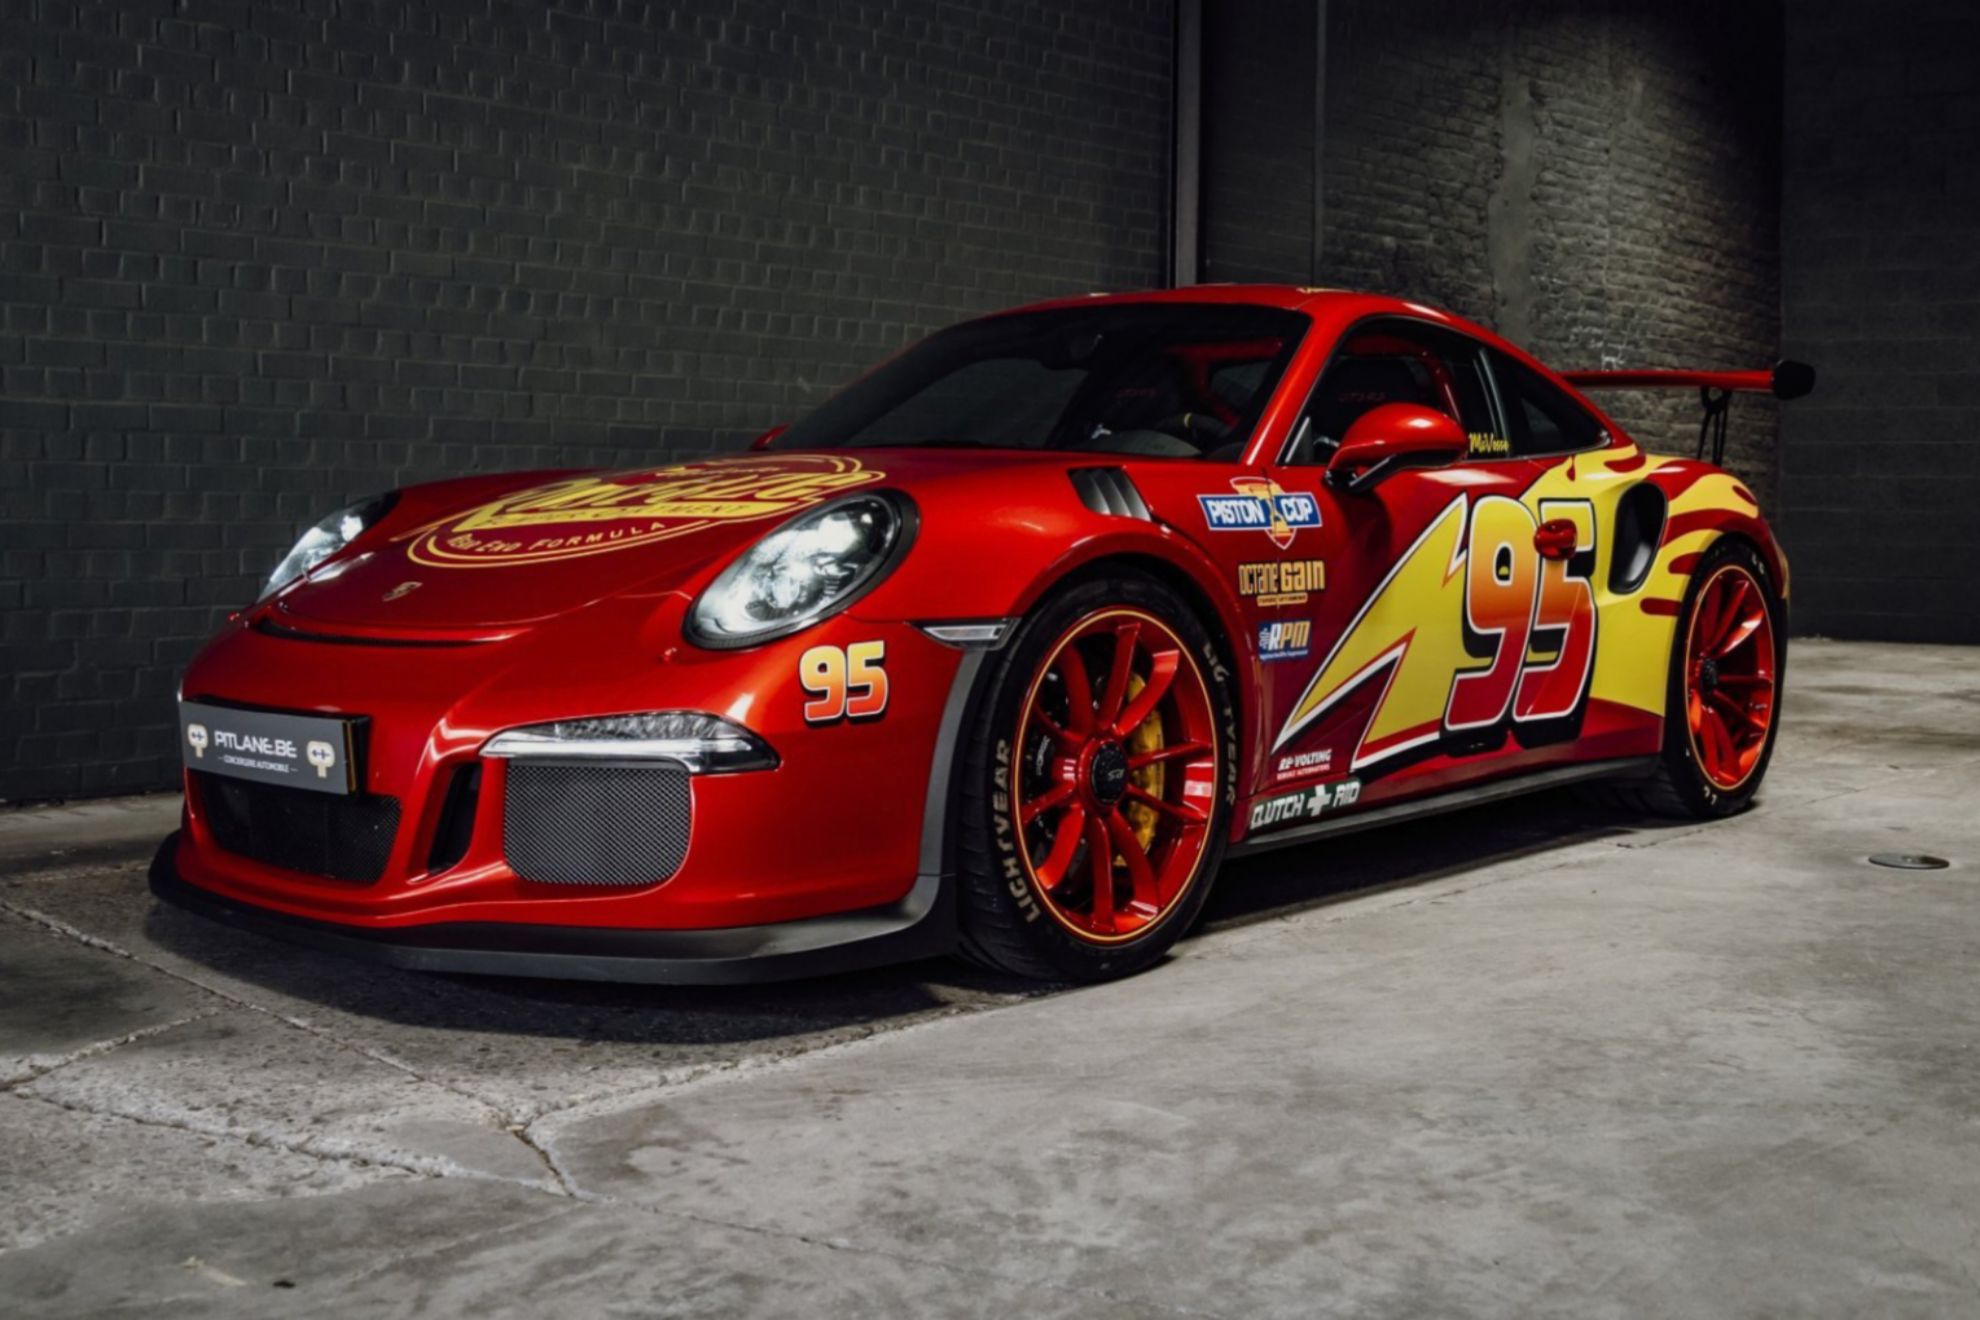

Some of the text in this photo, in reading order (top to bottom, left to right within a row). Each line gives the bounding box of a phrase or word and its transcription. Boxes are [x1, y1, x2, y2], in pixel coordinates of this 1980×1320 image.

[1205, 497, 1313, 524] PISTON CUP
[528, 522, 666, 550] FORMULA
[1268, 621, 1311, 650] RPM
[1441, 496, 1598, 748] 95
[800, 640, 889, 727] 95
[214, 730, 298, 758] PITLANE.BE
[1249, 794, 1305, 830] CLUTCH
[992, 738, 1041, 923] LIGHTYEAR
